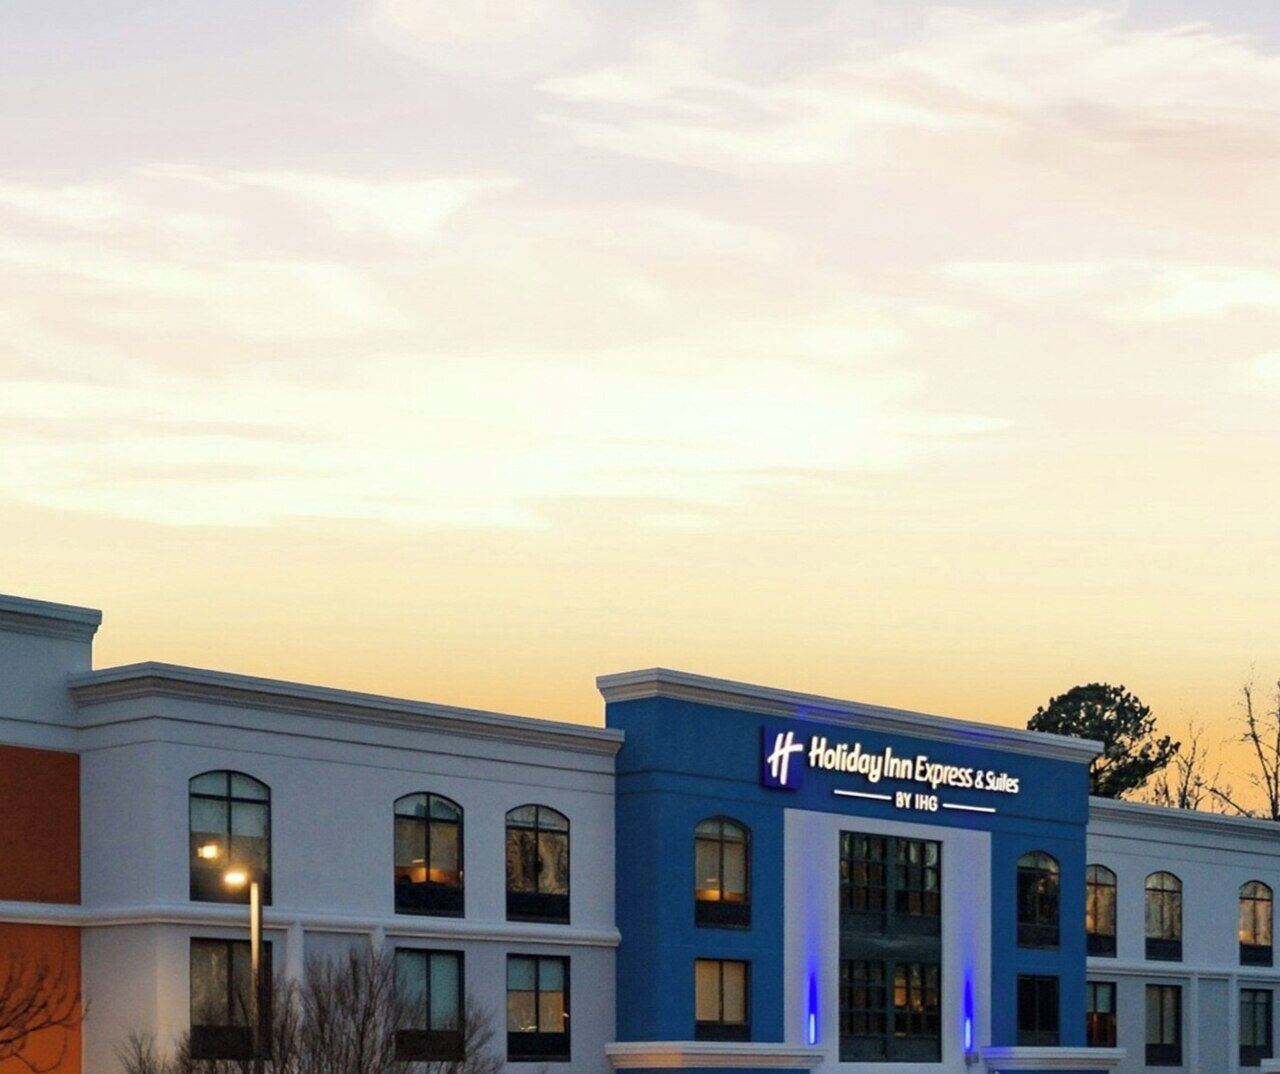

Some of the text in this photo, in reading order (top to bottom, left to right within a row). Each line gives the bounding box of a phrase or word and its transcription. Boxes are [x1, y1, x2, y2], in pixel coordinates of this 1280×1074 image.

[808, 736, 1020, 794] Holiday Inn Express & Suites
[895, 791, 938, 812] BY IHG
